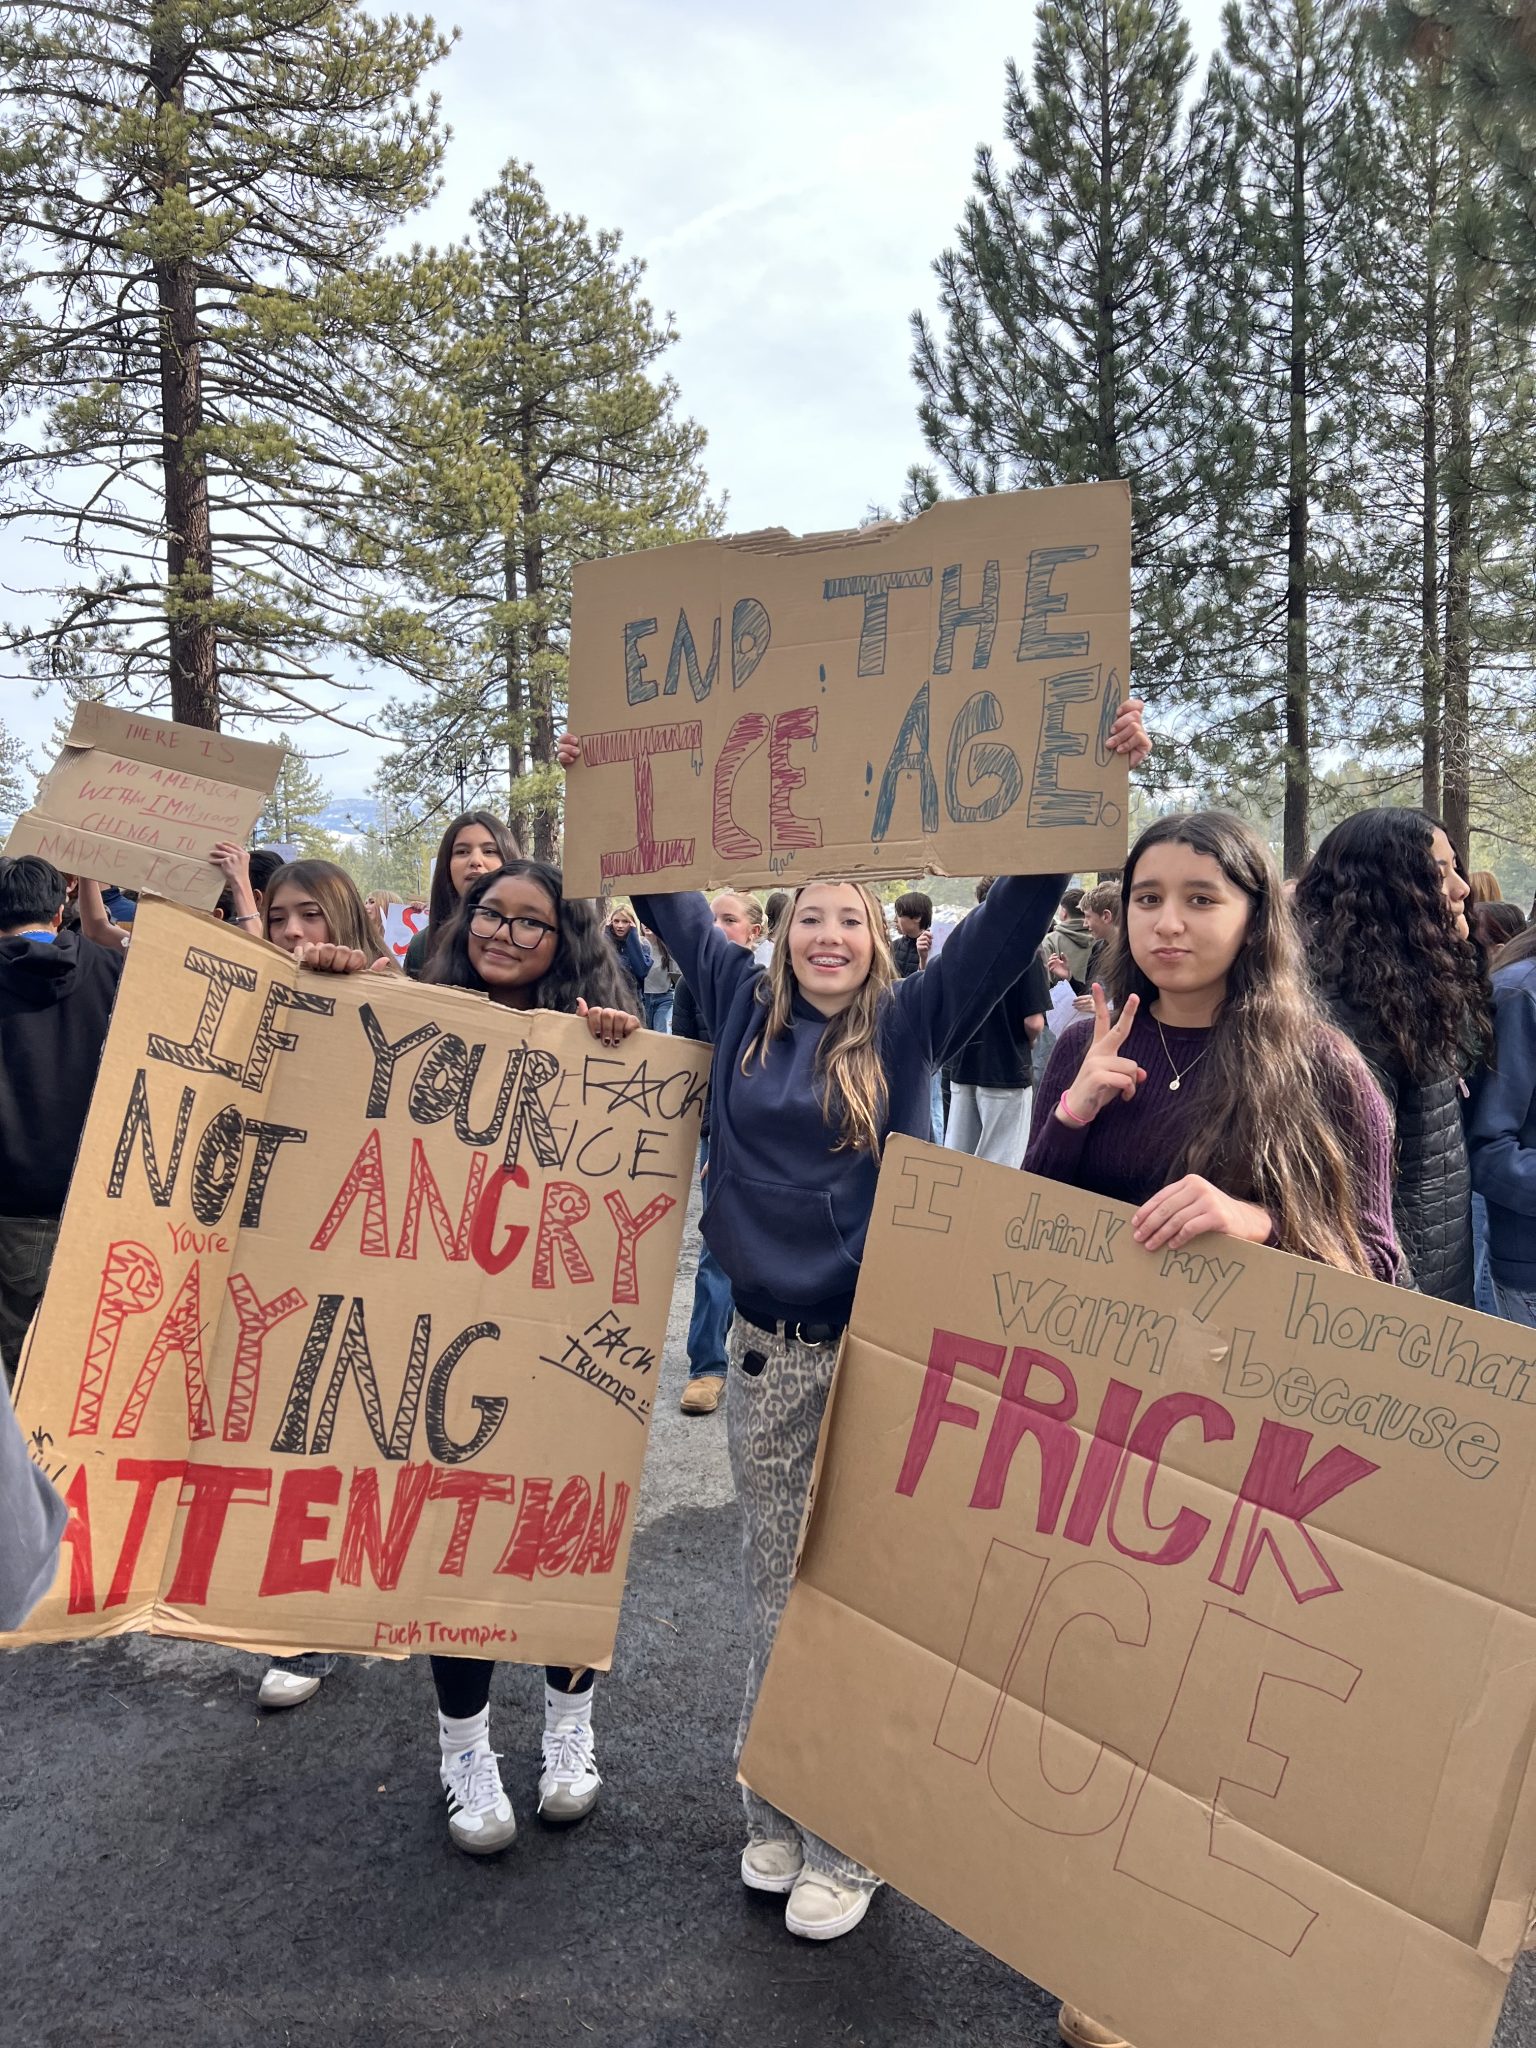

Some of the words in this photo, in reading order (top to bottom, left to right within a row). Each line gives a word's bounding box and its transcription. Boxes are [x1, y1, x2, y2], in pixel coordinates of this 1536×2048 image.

[621, 597, 771, 706] END
[822, 544, 1099, 677] THE
[108, 759, 140, 777] NO
[149, 769, 240, 800] AMERICA
[126, 723, 180, 749] THERE
[199, 740, 235, 764] IS
[580, 705, 823, 879] ICE
[37, 834, 130, 869] MADRE
[143, 853, 212, 893] ICE
[80, 812, 161, 845] CHINGA
[177, 835, 197, 850] TU
[147, 945, 336, 1092] IF
[106, 1068, 308, 1228] NOT
[309, 1128, 677, 1305] ANGRY
[559, 1119, 678, 1181] ICE
[166, 1221, 230, 1255] Youre
[892, 1156, 962, 1234] I
[1005, 1192, 1126, 1264] drink
[1159, 1249, 1246, 1323] my
[68, 1239, 509, 1464] PAYING
[1222, 1328, 1501, 1480] because
[59, 1459, 630, 1615] ATTENTION
[895, 1327, 1382, 1605] FRICK
[374, 1620, 422, 1648] Fuck
[933, 1537, 1363, 1958] ICE
